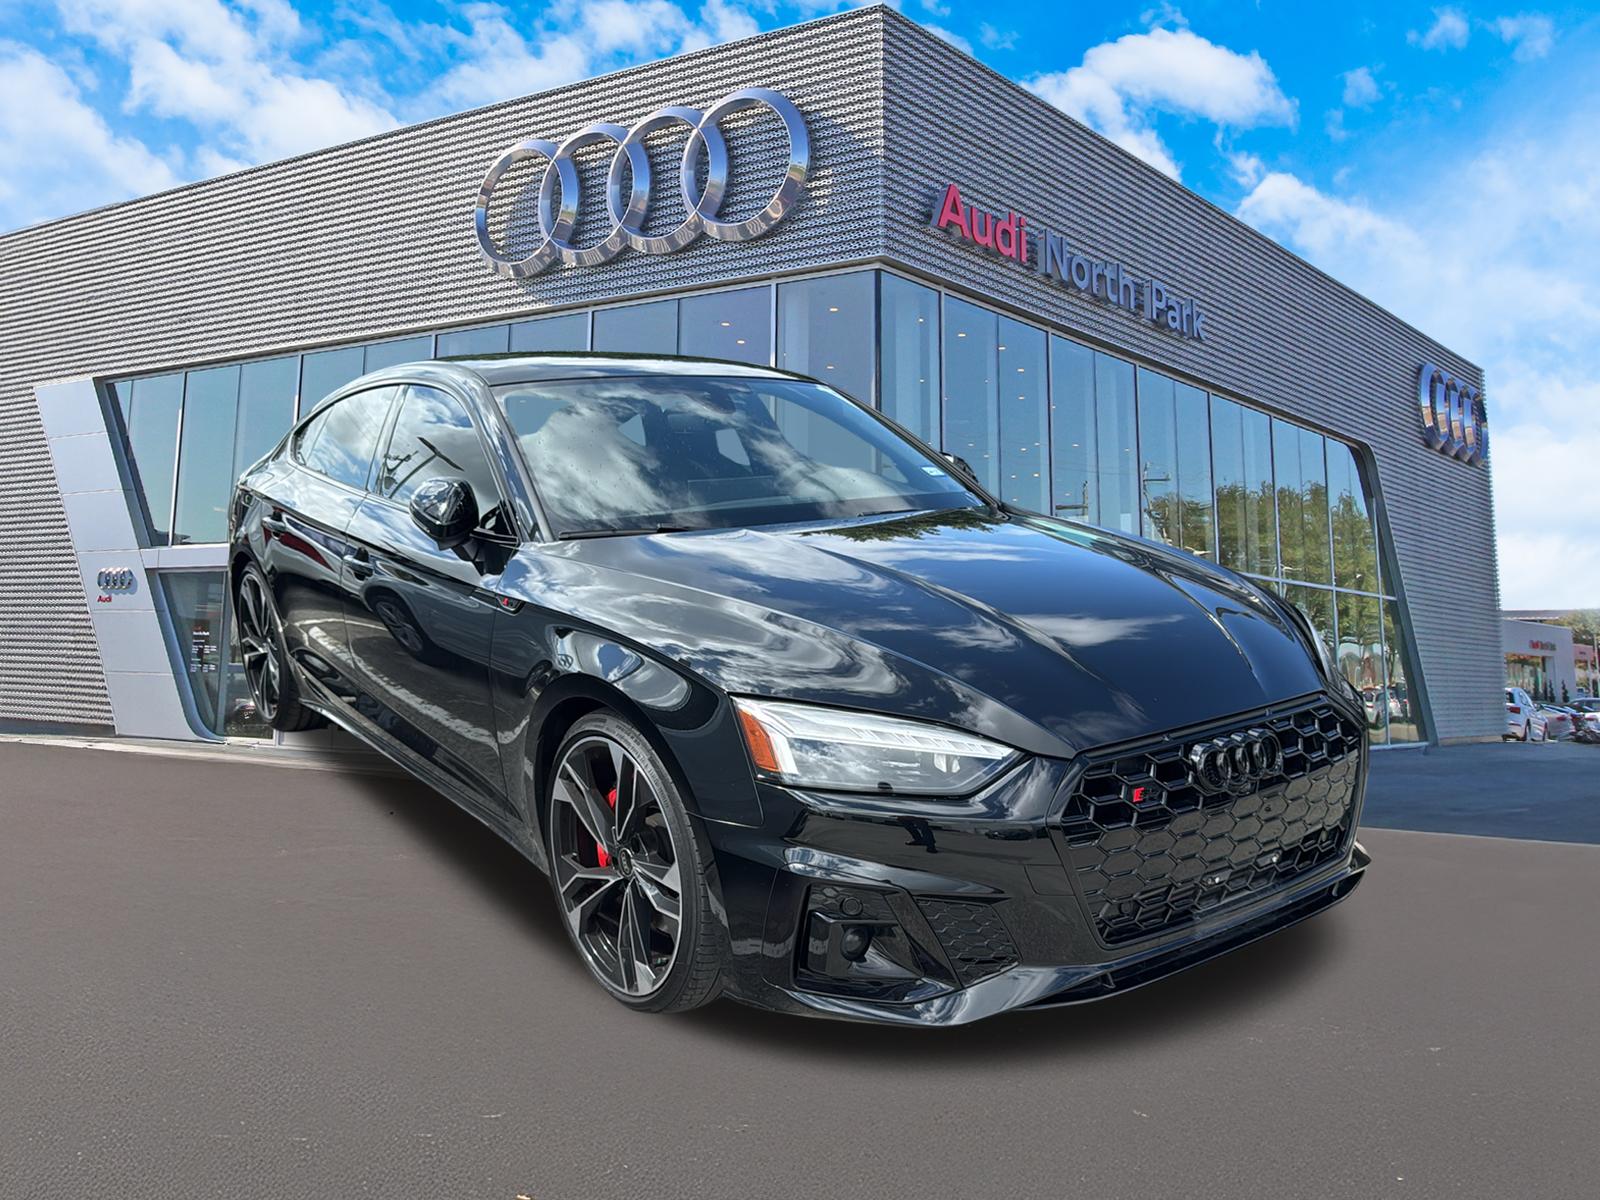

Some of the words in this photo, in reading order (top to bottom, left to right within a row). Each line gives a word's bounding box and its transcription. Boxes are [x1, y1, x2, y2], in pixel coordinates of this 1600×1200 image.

[934, 183, 1028, 264] Audi
[1039, 228, 1136, 310] North
[1144, 278, 1207, 341] Park
